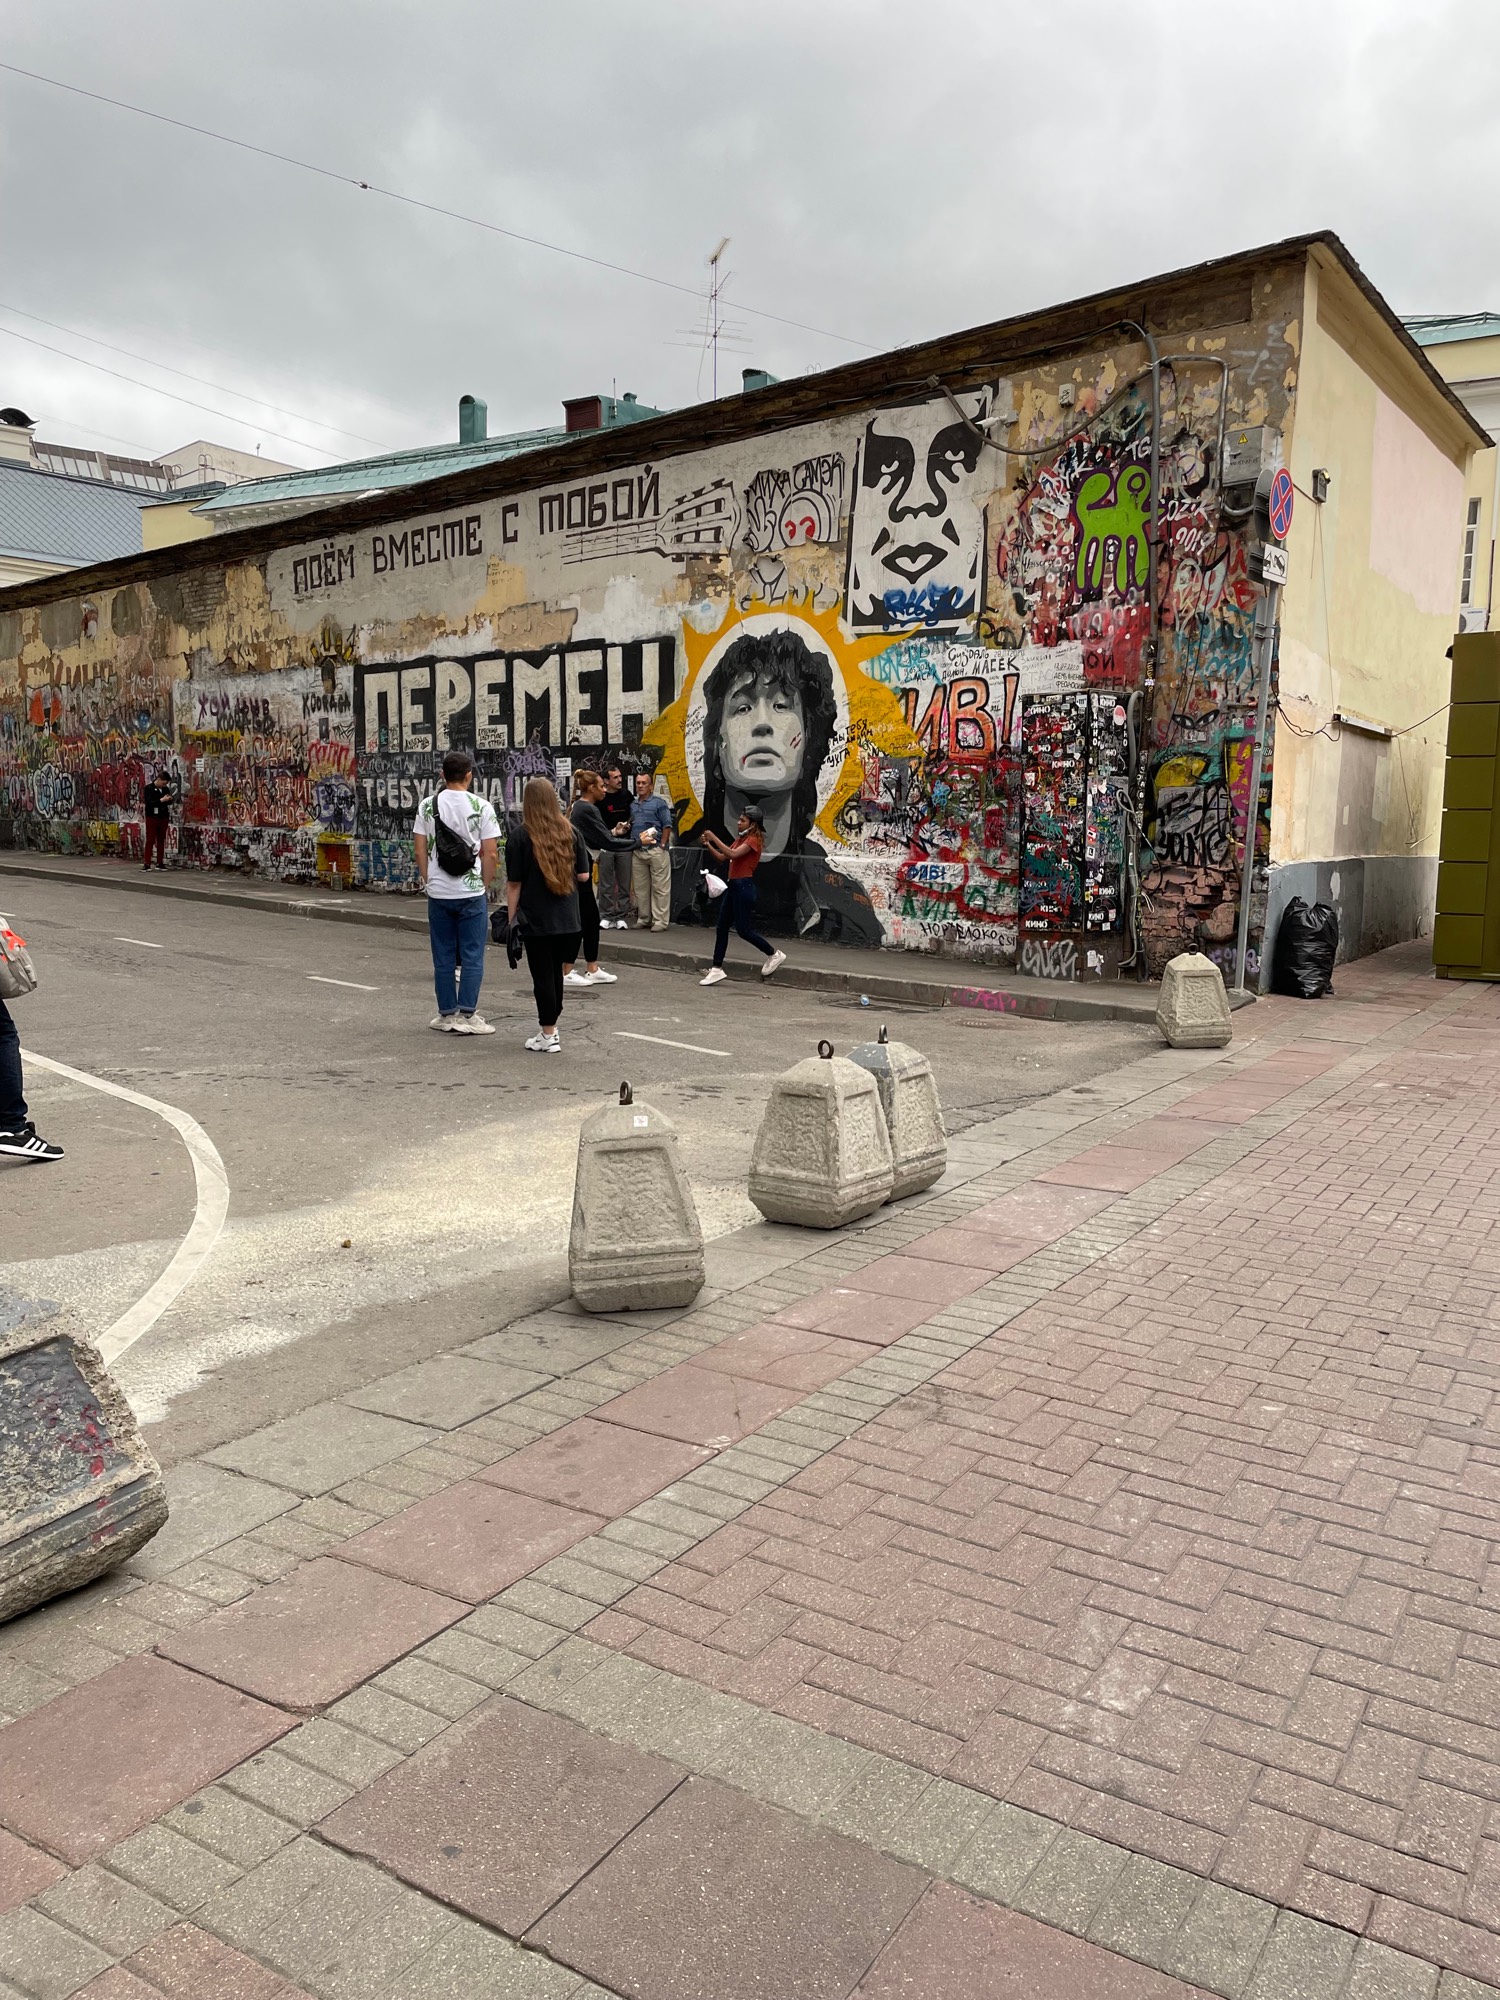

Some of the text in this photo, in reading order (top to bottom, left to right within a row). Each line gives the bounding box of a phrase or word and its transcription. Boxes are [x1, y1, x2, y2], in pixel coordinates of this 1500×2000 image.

[292, 463, 662, 595] ПОЁМ ВМЕСТЕ С ТОБОЙ
[363, 641, 660, 754] ПЕРЕМЕН
[899, 672, 1021, 759] ИВ!
[1028, 744, 1051, 753] КНО
[1025, 918, 1049, 929] КИНО
